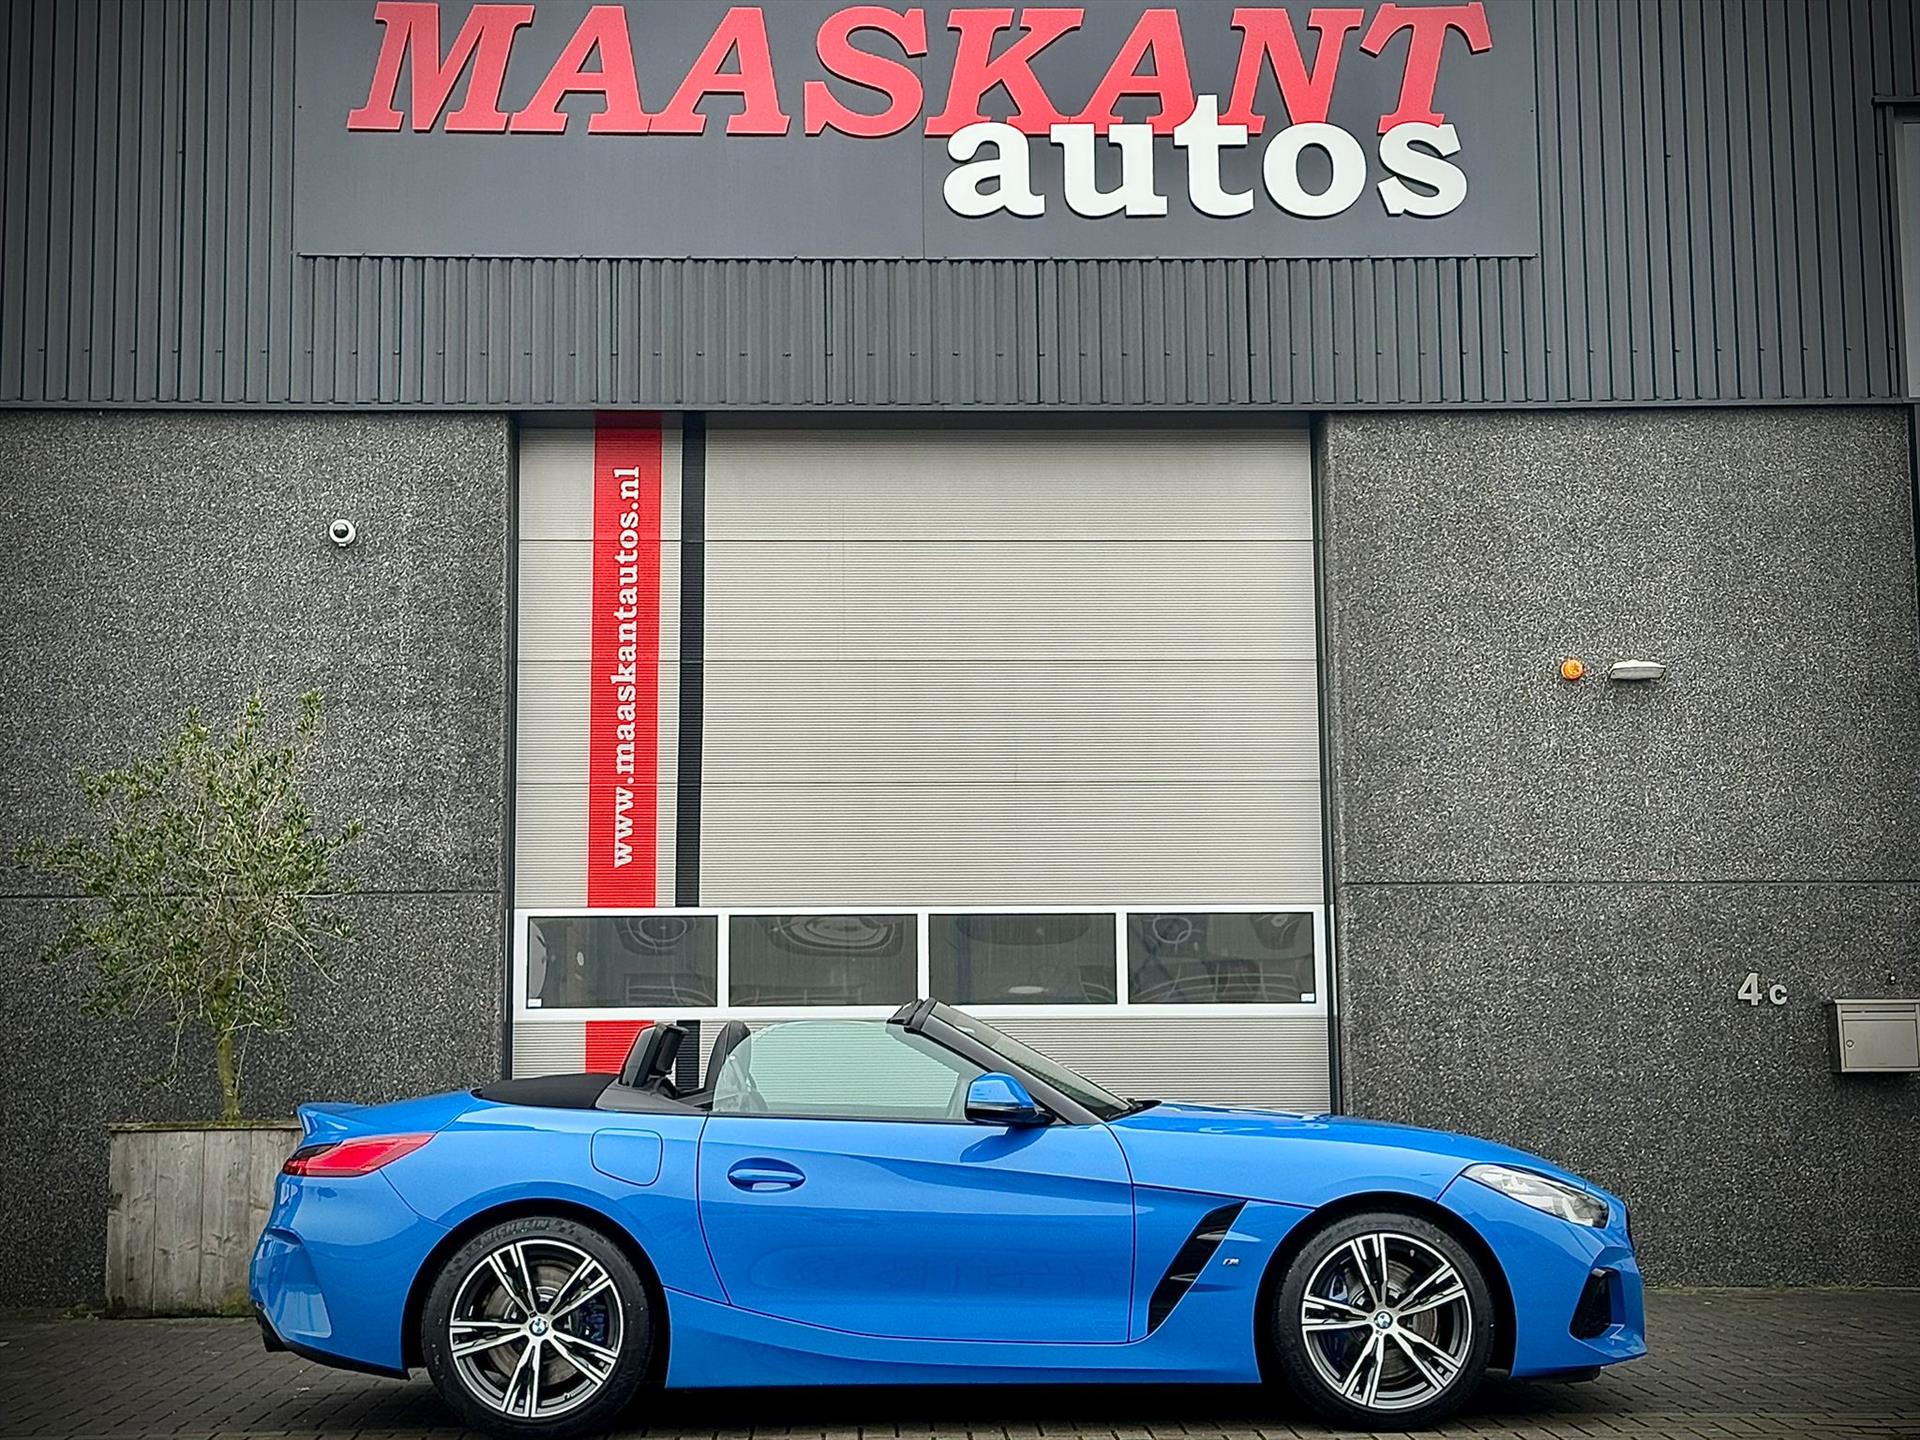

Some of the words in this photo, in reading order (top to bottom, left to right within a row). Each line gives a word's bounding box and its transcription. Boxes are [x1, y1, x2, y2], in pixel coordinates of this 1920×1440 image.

[347, 1, 1493, 138] MAASKANT
[942, 94, 1468, 218] autos
[611, 466, 640, 868] www.maaskantautos.nl
